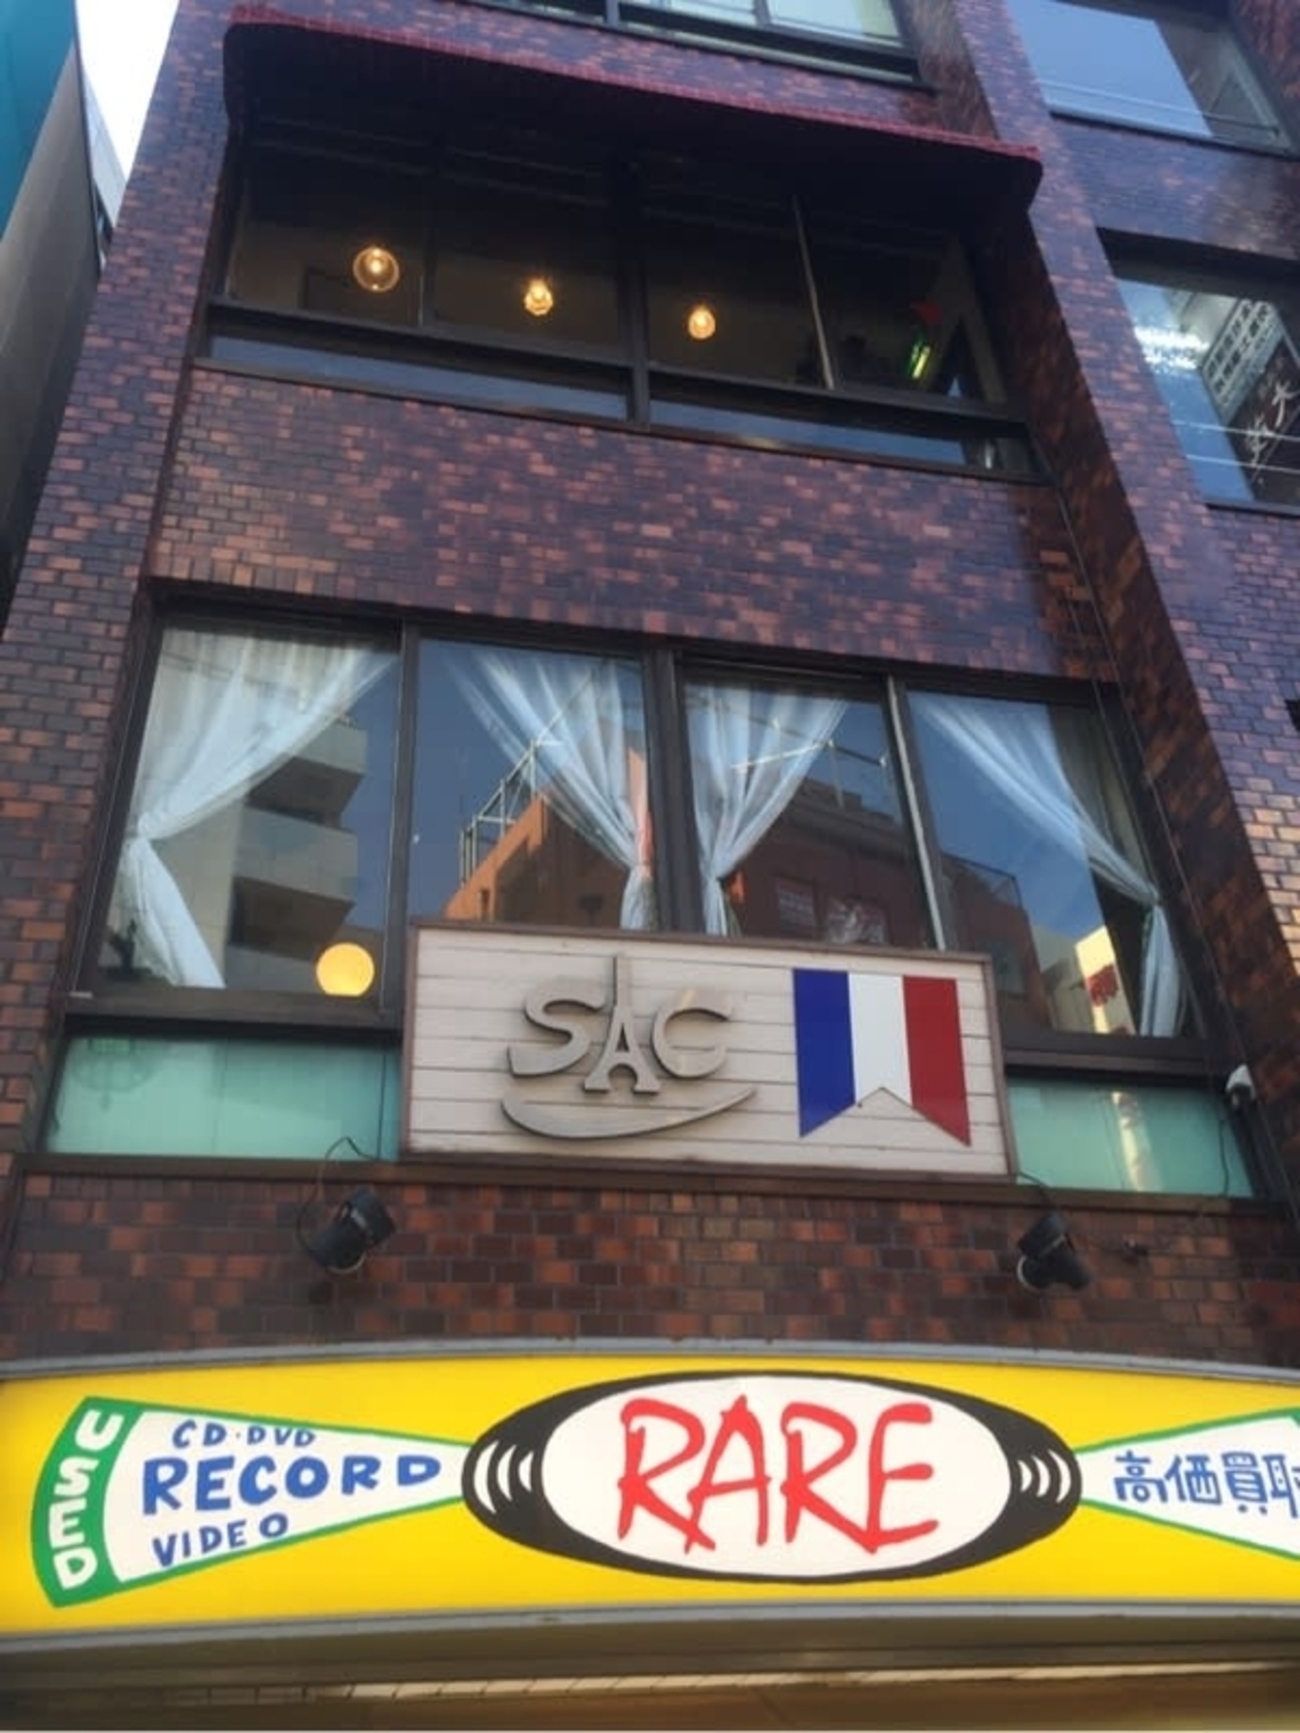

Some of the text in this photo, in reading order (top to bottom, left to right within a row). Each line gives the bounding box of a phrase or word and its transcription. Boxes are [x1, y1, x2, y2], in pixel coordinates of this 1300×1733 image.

[49, 1409, 124, 1590] USED
[142, 1454, 441, 1516] RECORD
[617, 1395, 939, 1554] RARE
[152, 1512, 289, 1568] VIDEO
